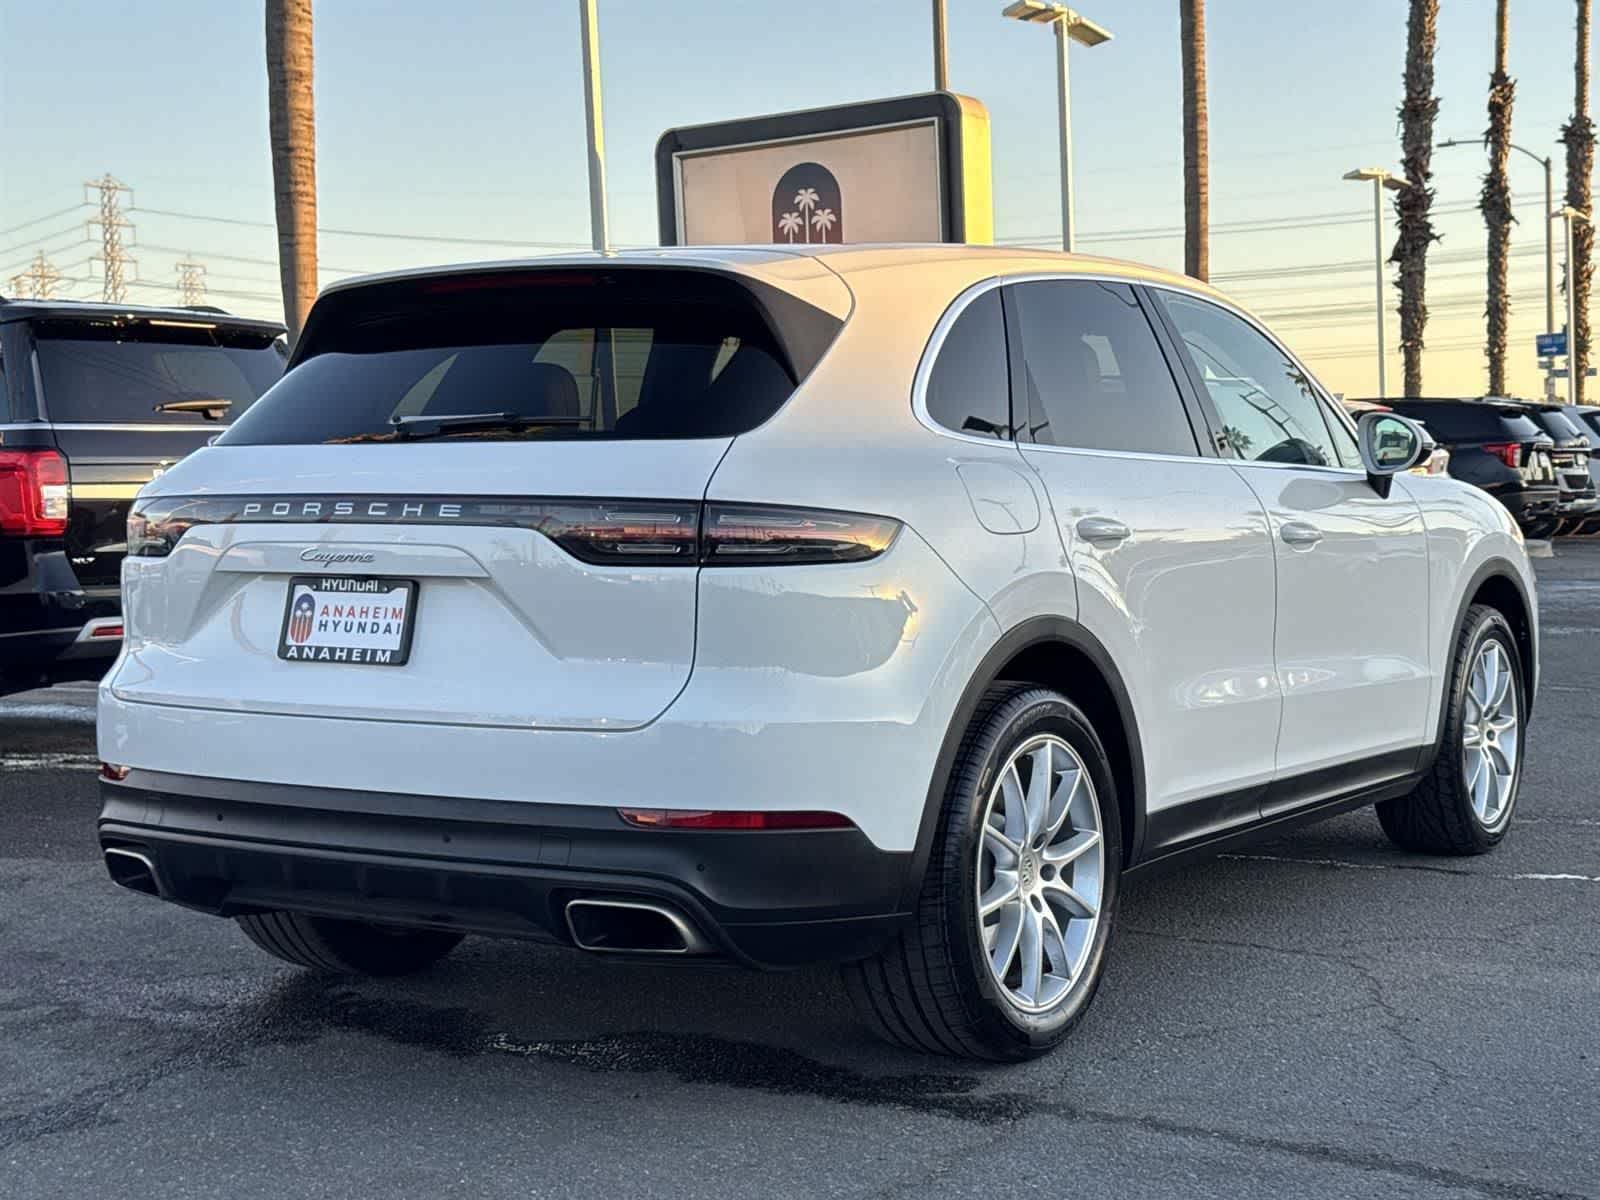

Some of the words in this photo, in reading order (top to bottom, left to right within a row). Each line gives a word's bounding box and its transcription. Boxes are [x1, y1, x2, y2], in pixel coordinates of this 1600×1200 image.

[243, 502, 462, 517] PORSCHE
[300, 546, 376, 568] Cayenne
[321, 578, 378, 592] HYUNDAI
[320, 604, 403, 620] ANAHEIM
[318, 620, 401, 635] HYUNDAI
[287, 645, 391, 663] ANAHEIM
